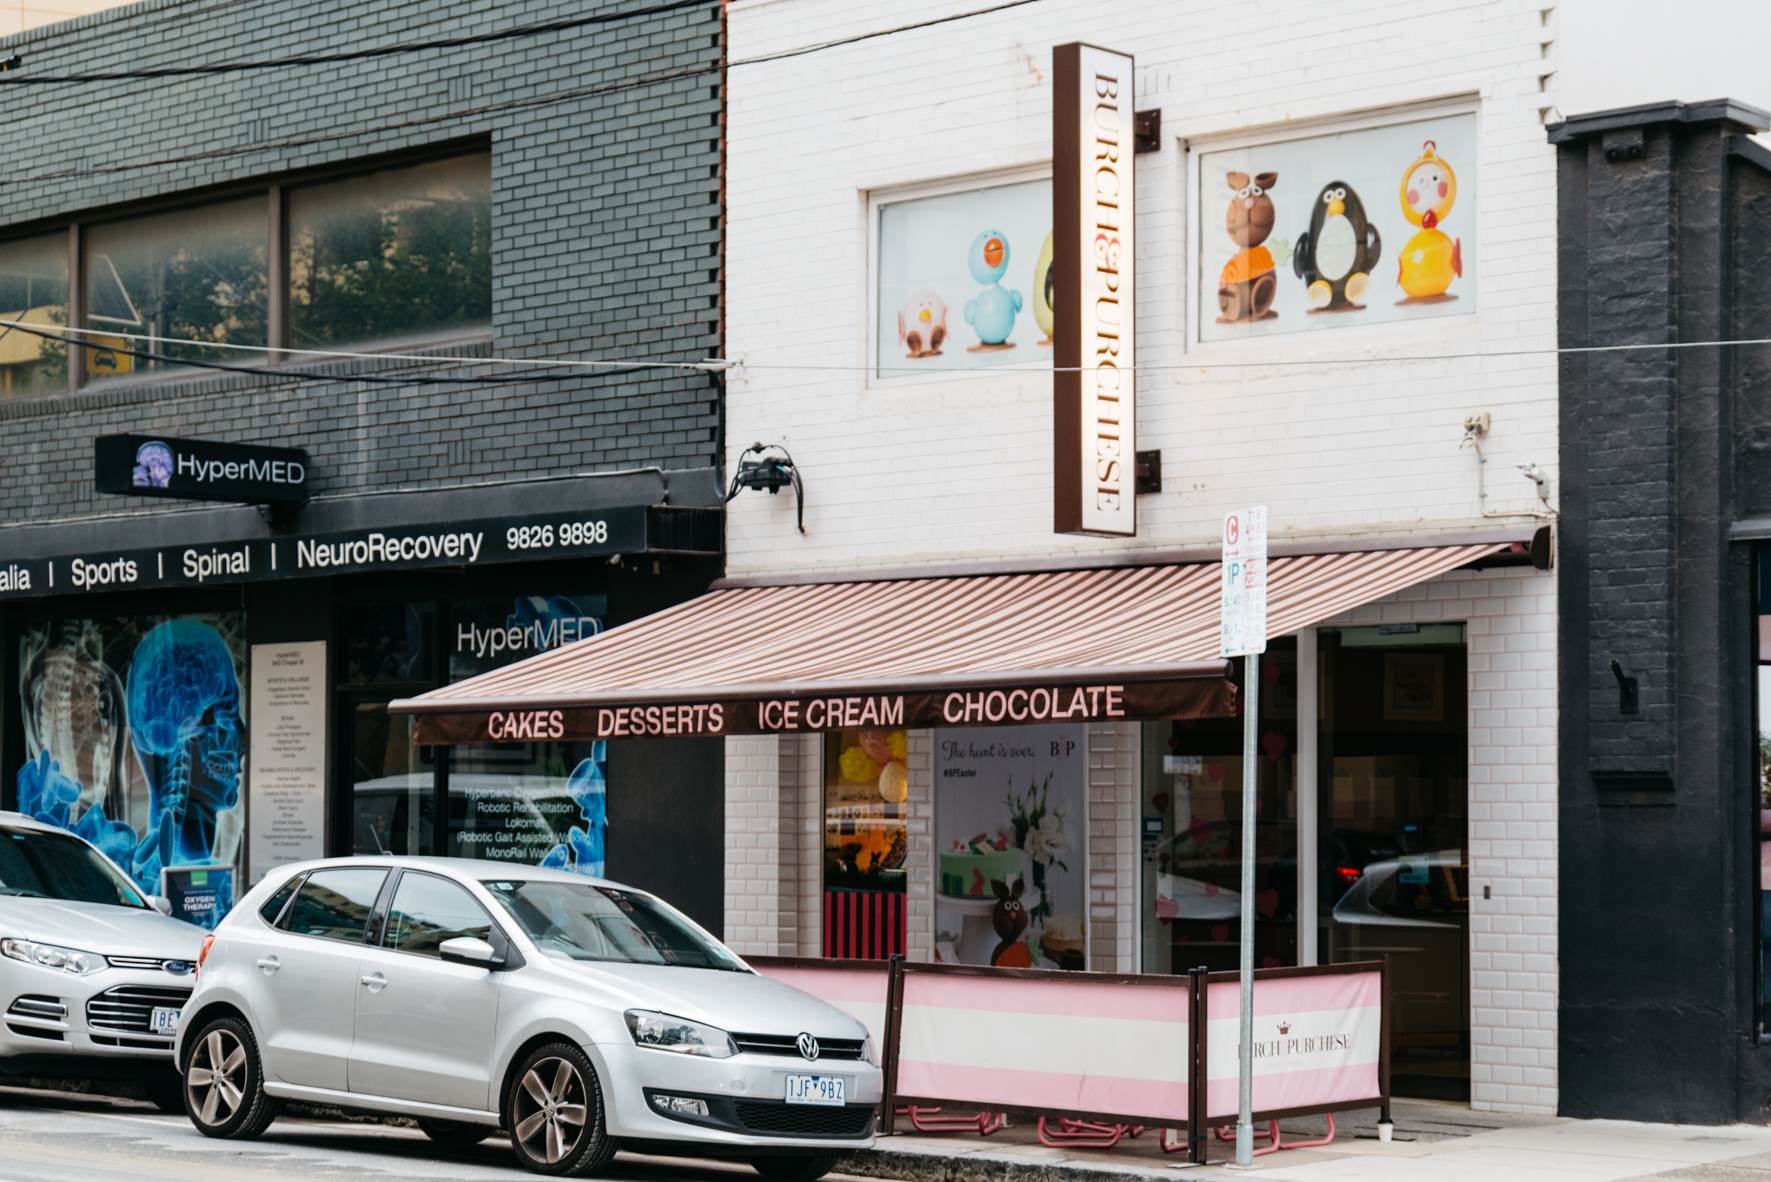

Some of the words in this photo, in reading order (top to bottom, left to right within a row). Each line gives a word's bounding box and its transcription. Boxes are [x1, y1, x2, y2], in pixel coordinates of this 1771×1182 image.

[1095, 69, 1119, 236] BURCH
[1096, 263, 1121, 511] PURCHESE
[177, 453, 305, 484] HyperMED
[71, 557, 138, 591] Sports
[183, 545, 250, 582] Spinal
[297, 532, 484, 568] NeuroRecovery
[506, 525, 554, 550] 9826
[559, 520, 608, 546] 9898
[1227, 563, 1240, 586] 1P
[457, 616, 599, 658] HyperMED
[488, 710, 564, 739] CAKES
[598, 703, 724, 737] DESSERTS
[758, 700, 800, 729] ICE
[805, 696, 904, 728] CREAM
[942, 685, 1125, 723] CHOCOLATE
[942, 740, 966, 760] The
[969, 742, 996, 758] hunt
[998, 743, 1007, 758] is
[943, 768, 977, 778] #BPEaster
[477, 802, 511, 814] Robotic
[457, 831, 494, 843] (Robotic
[495, 831, 513, 843] Gait
[515, 832, 553, 843] Assisted
[486, 847, 527, 858] MonoRail
[183, 902, 217, 911] THERAPY
[184, 895, 216, 904] OXYGEN
[169, 960, 185, 971] Ford
[1287, 1033, 1351, 1055] PURCHESE
[790, 1079, 811, 1097] 1JF
[820, 1081, 842, 1099] 9BZ
